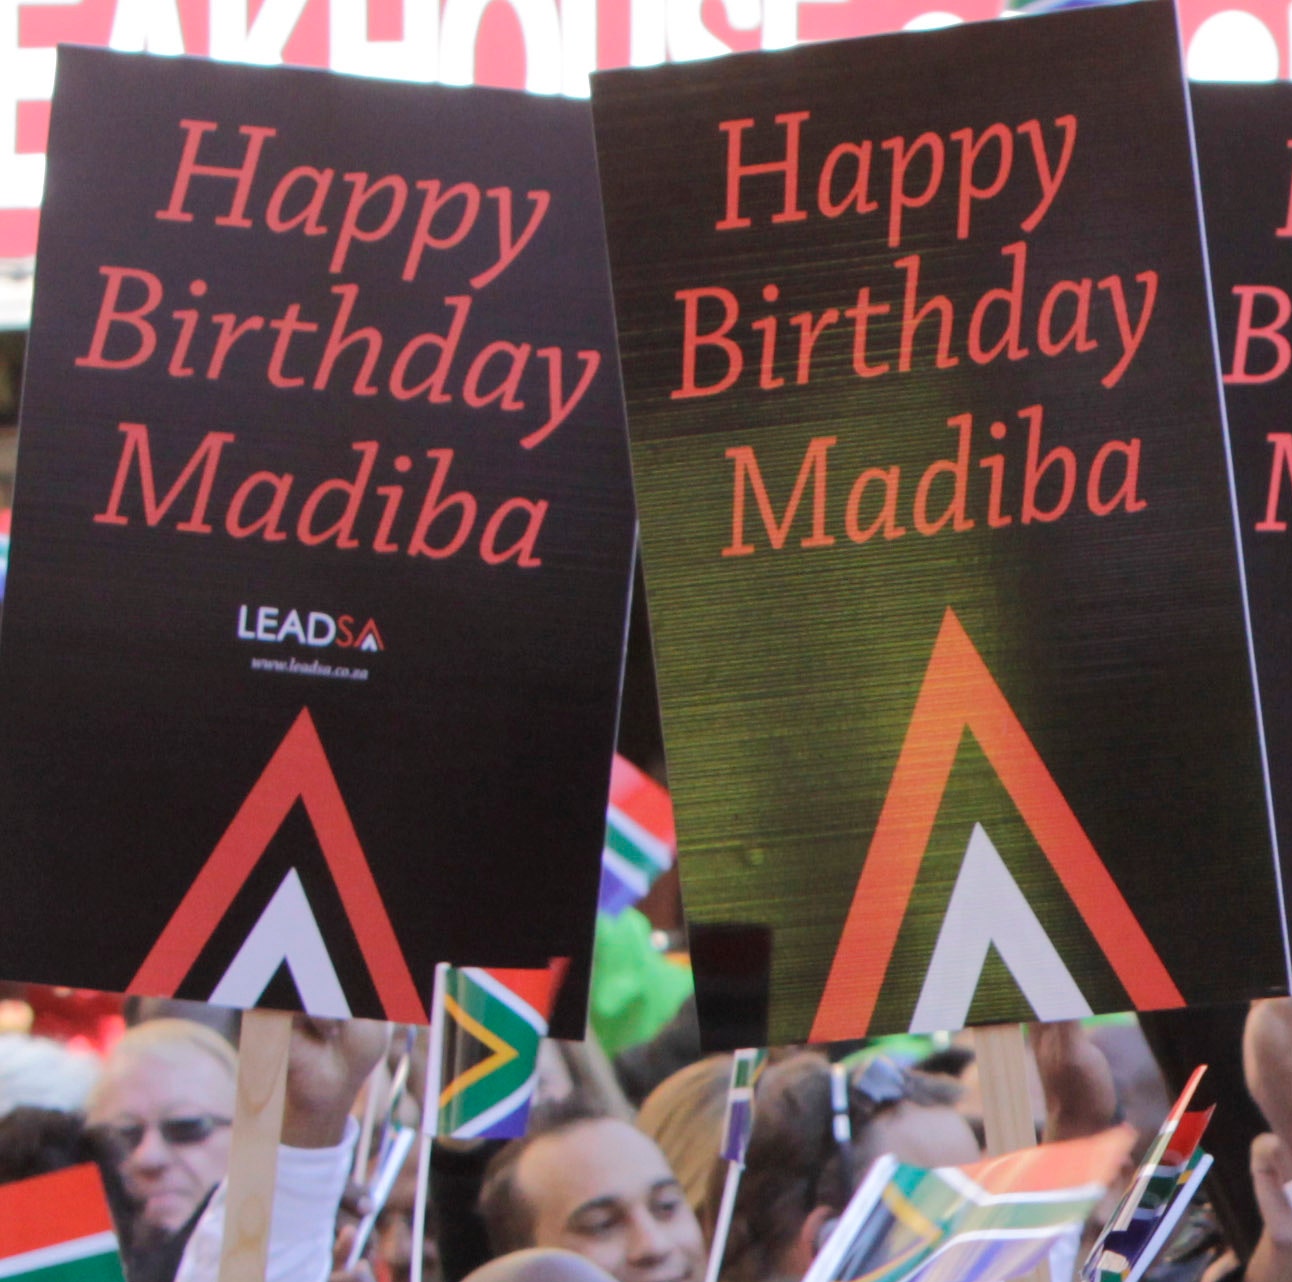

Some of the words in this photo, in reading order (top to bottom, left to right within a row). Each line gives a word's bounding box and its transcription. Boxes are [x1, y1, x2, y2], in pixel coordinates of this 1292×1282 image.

[156, 119, 551, 289] Happy
[715, 111, 1078, 248] Happy
[75, 266, 601, 448] Birthday
[670, 241, 1159, 399] Birthday
[93, 422, 549, 567] Madiba
[721, 404, 1148, 556] Madiba
[237, 604, 385, 652] LEADSA
